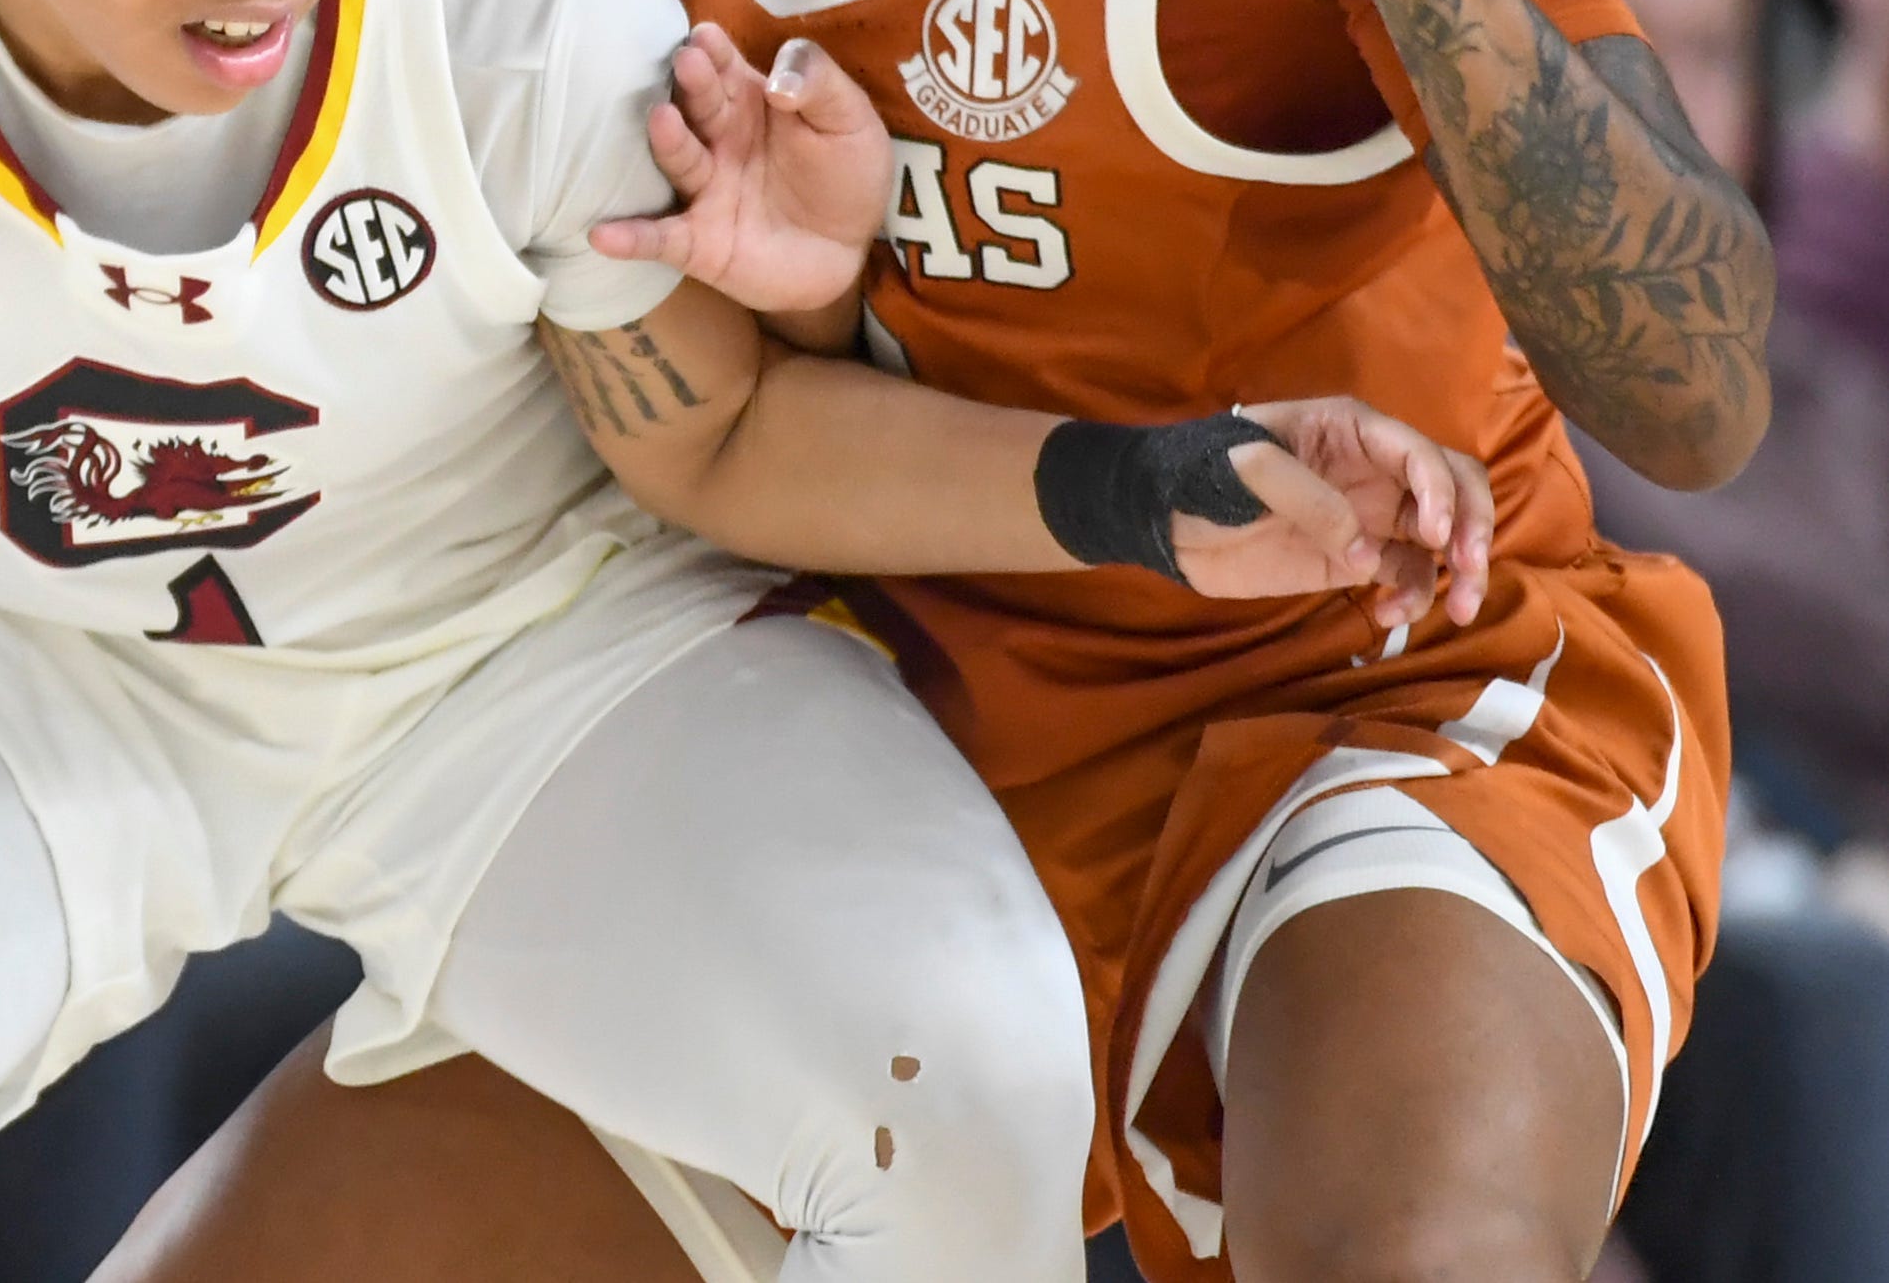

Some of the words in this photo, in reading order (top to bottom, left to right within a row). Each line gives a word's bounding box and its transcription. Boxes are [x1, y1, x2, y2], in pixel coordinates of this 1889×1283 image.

[916, 82, 1053, 140] GRADUATE
[311, 196, 428, 305] SEC
[877, 135, 1075, 291] AS
